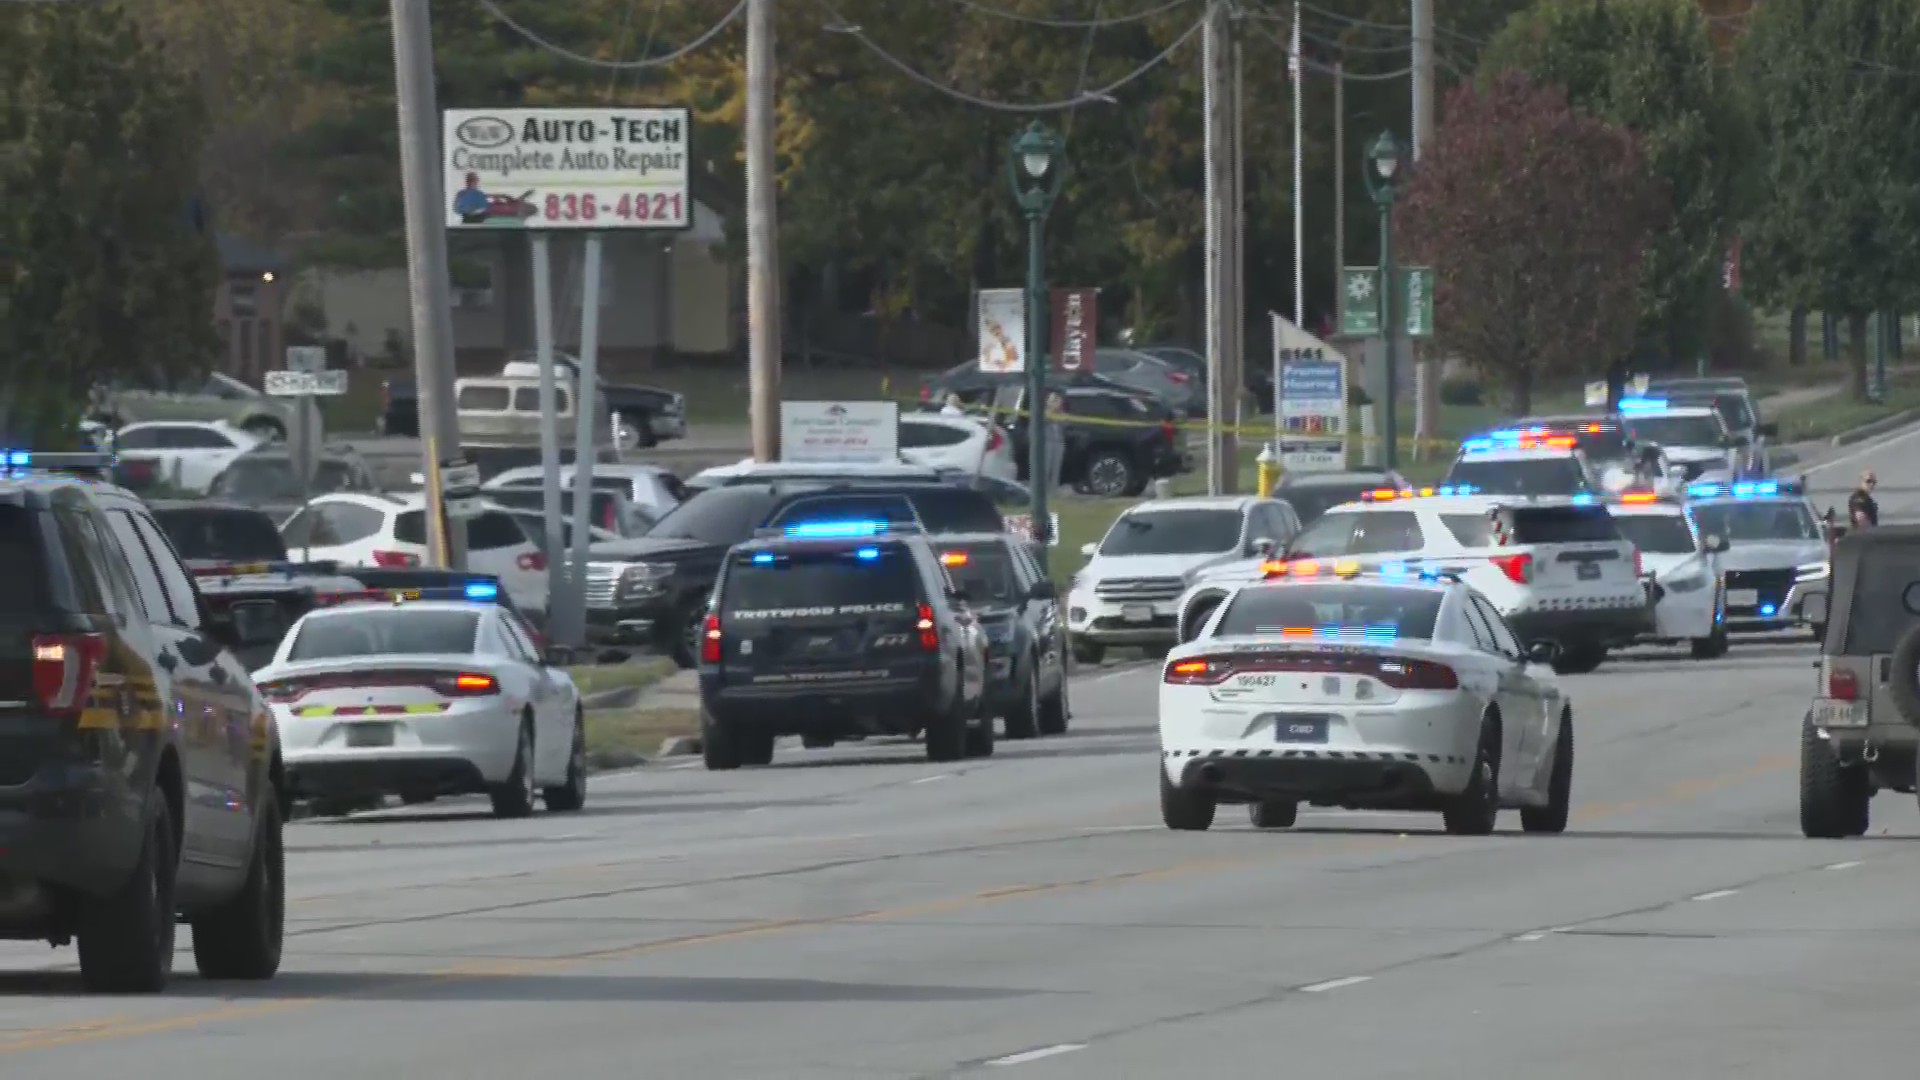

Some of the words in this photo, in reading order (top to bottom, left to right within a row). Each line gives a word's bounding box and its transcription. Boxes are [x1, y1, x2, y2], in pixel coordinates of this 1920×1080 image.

[522, 117, 681, 143] AUTO-TECH
[452, 148, 554, 176] Complete
[559, 148, 610, 170] Auto
[613, 148, 682, 175] Repair
[545, 193, 681, 221] 836-4821
[839, 602, 903, 614] POLICE
